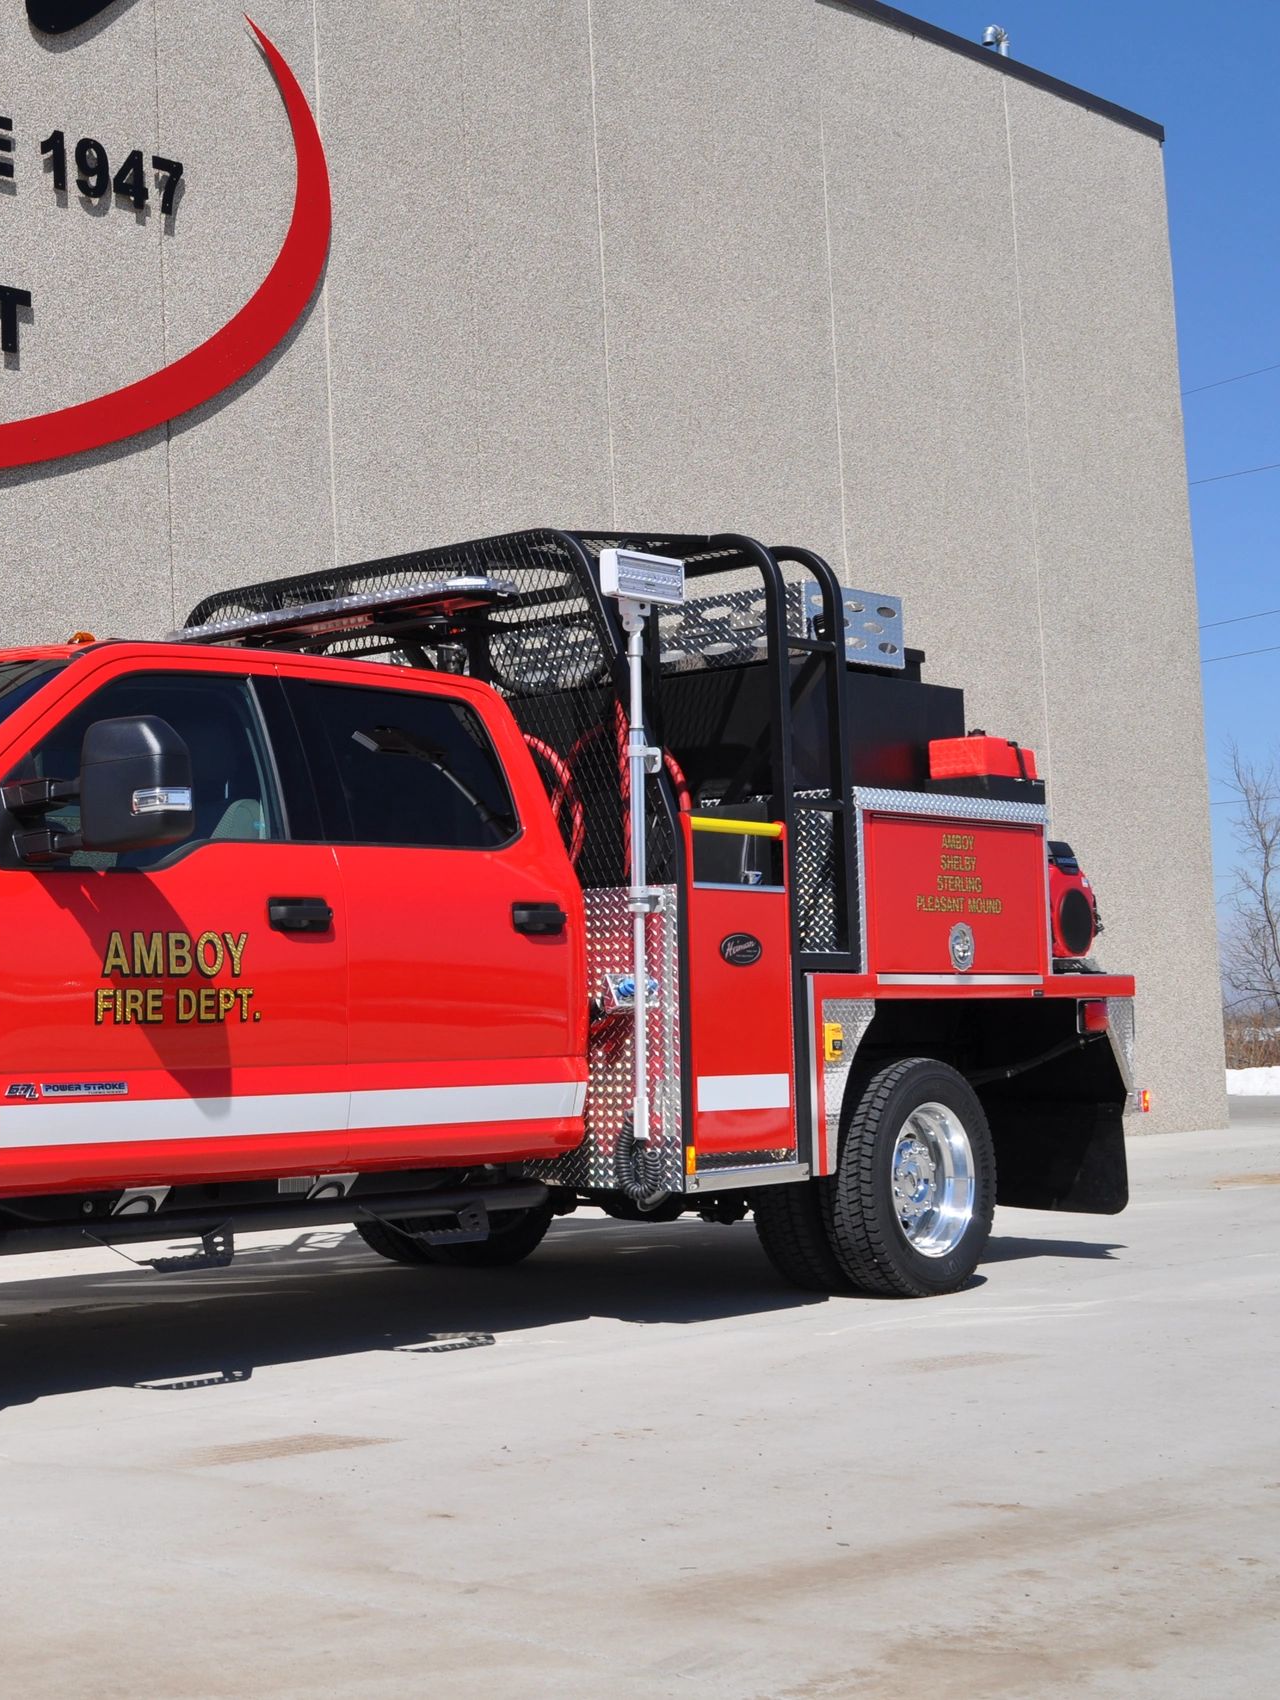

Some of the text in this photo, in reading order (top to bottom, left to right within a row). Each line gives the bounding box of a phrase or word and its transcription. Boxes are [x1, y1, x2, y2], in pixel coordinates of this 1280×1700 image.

[40, 130, 184, 215] 1947
[941, 834, 975, 850] AMBOY
[940, 855, 977, 871] SHELBY
[937, 875, 983, 893] STERLING
[916, 895, 1002, 914] PLEASANT MOUND
[101, 931, 249, 978] AMBOY
[95, 988, 261, 1024] FIRE DEPT.
[44, 1082, 126, 1092] POWER STROKE
